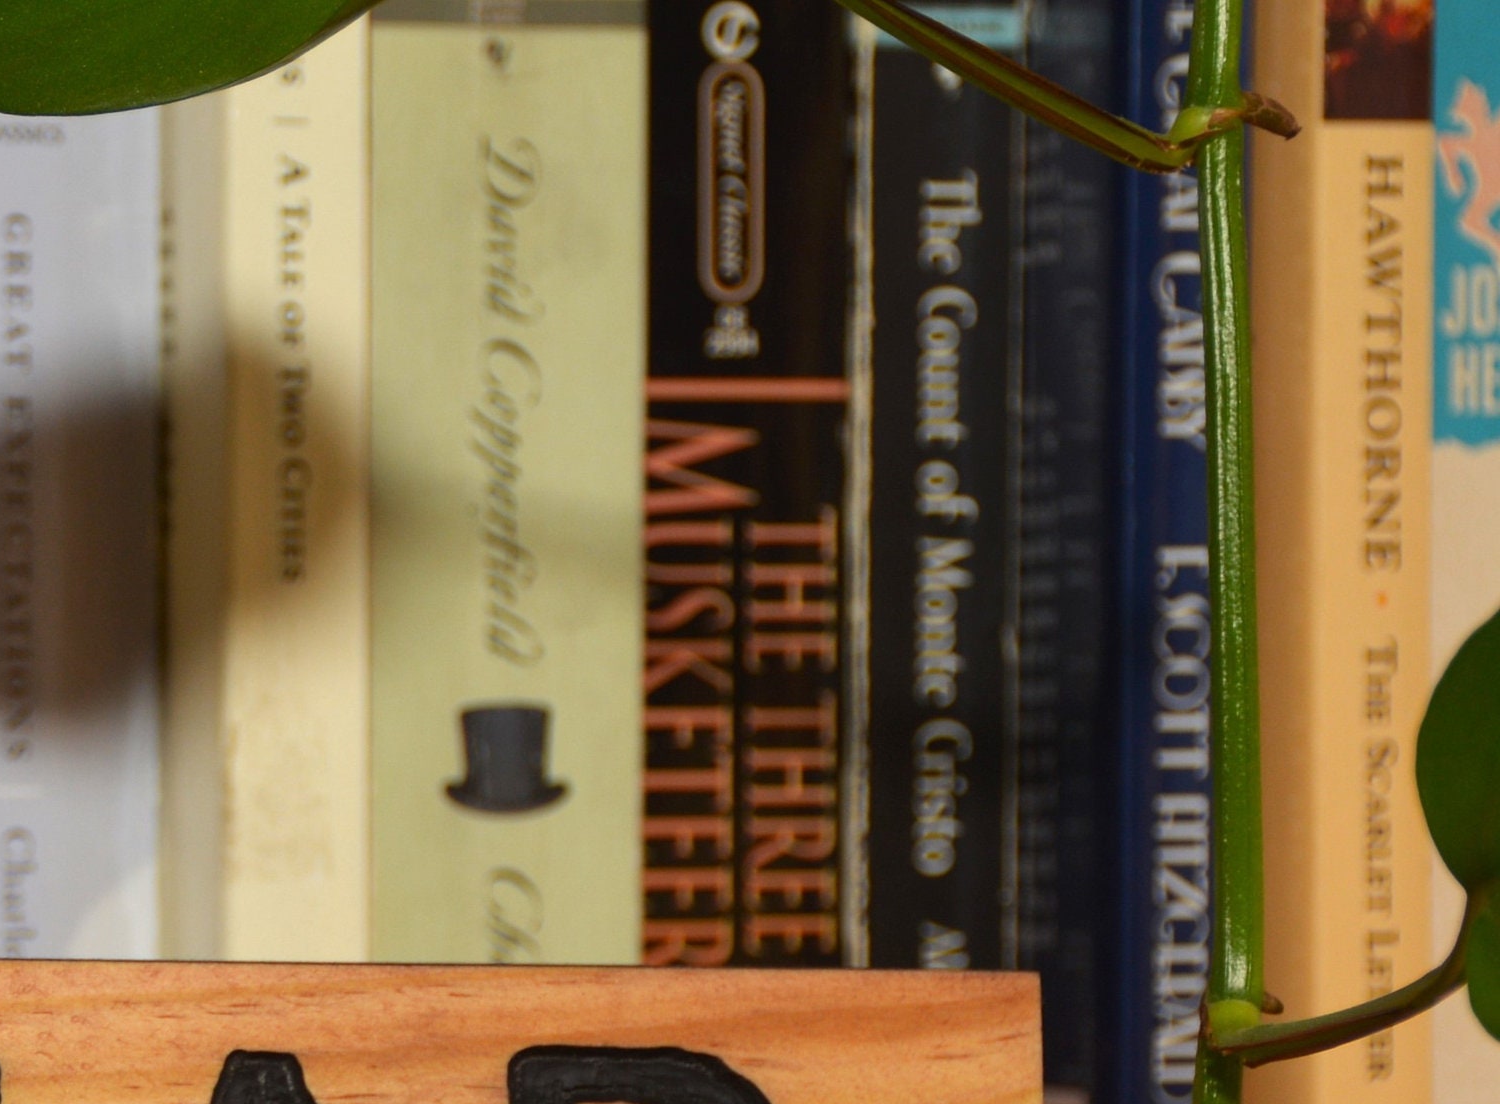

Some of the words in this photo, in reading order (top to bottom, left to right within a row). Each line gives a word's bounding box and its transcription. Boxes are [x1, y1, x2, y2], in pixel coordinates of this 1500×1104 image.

[918, 168, 982, 274] The
[916, 285, 978, 449] Count
[1365, 154, 1404, 574] HAWTHORNE
[915, 460, 980, 526] of
[747, 505, 837, 673] THE
[913, 536, 974, 708] Monte
[744, 689, 837, 957] THREE
[912, 718, 973, 877] Cristo
